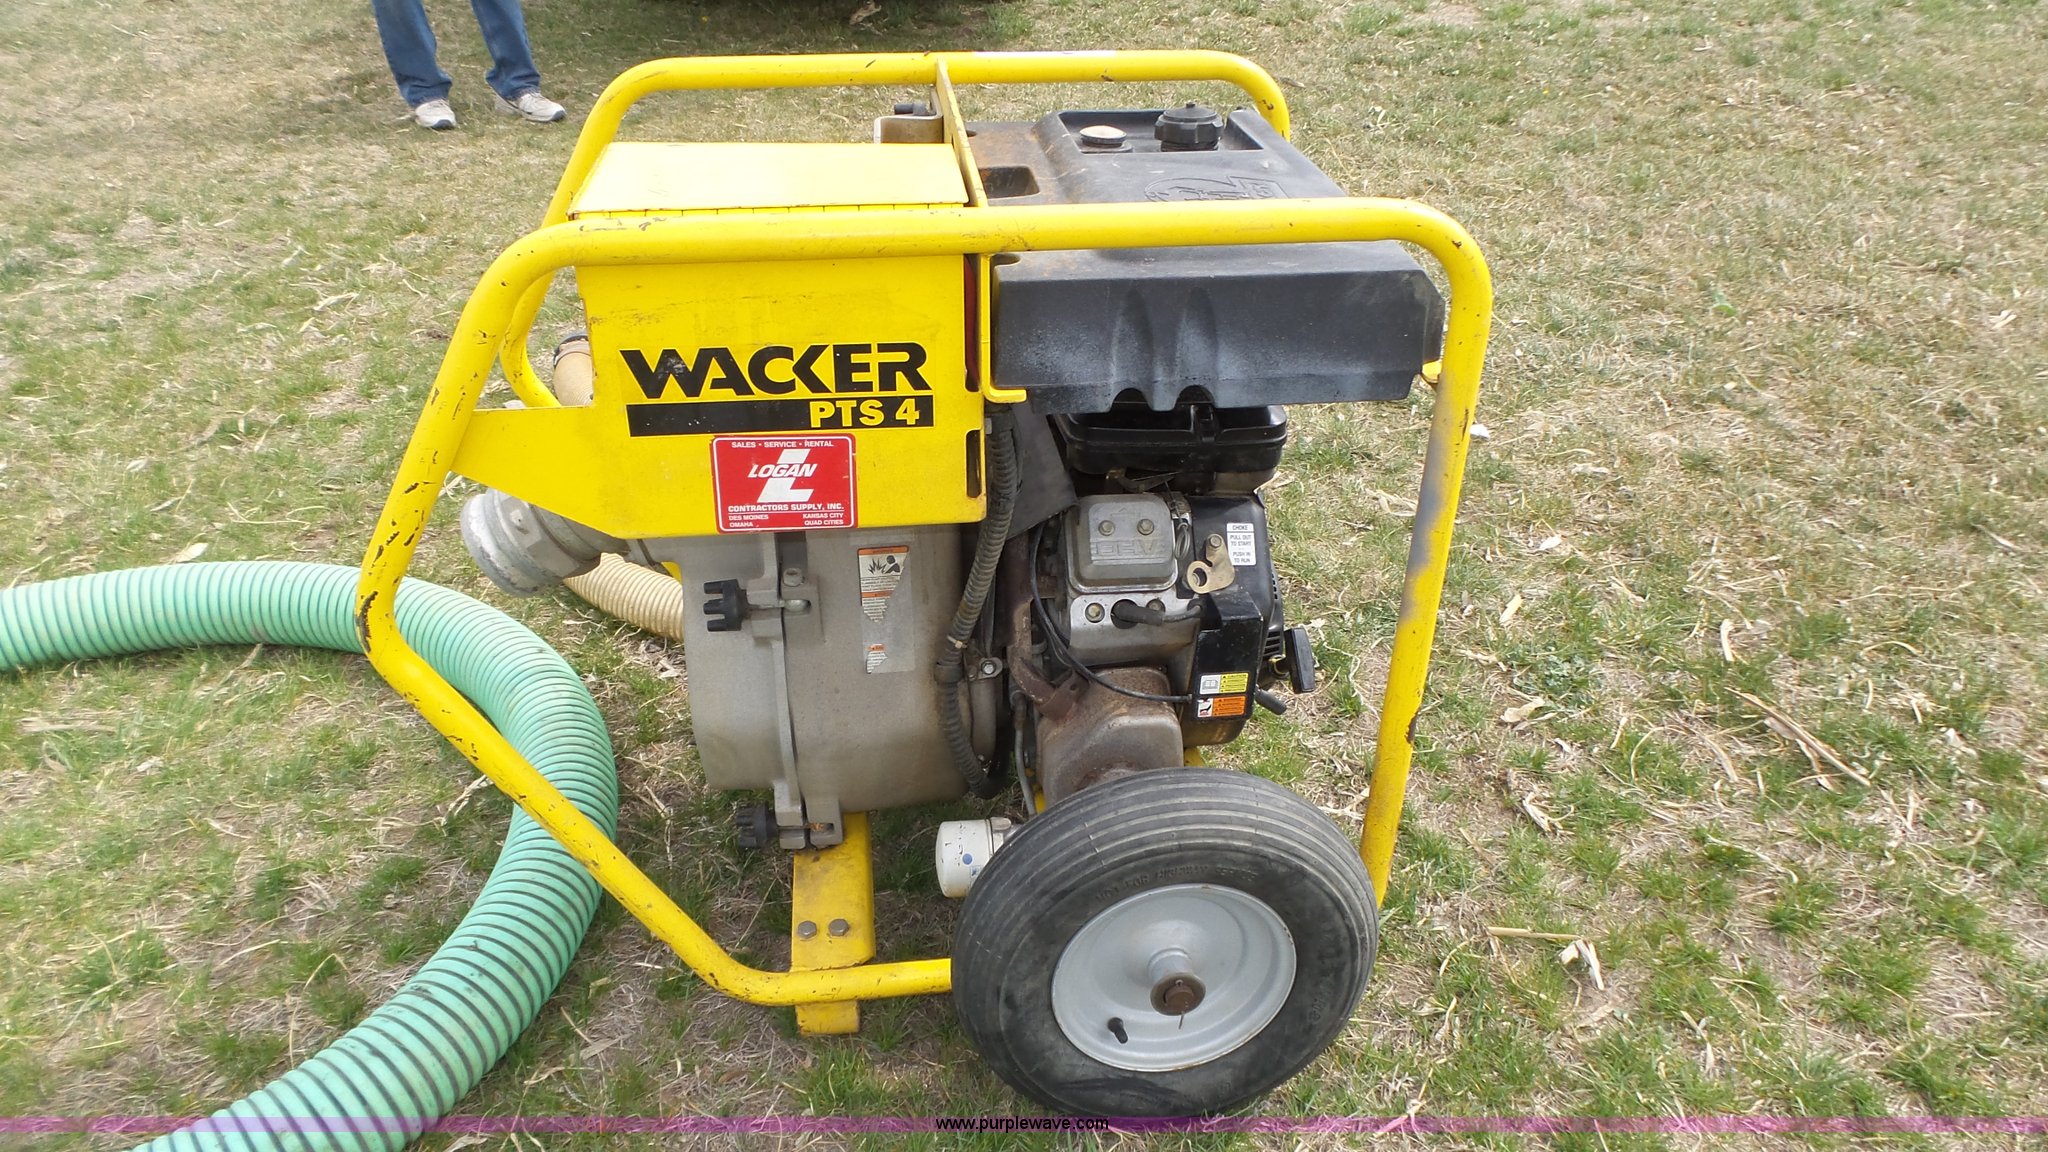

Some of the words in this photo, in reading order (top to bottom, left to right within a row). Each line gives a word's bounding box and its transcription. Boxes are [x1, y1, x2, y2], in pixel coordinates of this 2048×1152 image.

[619, 342, 932, 399] WACKER
[809, 400, 884, 428] PTS
[895, 398, 920, 425] 4
[747, 463, 818, 478] LOGAN
[728, 504, 789, 512] CONTRACTORS
[790, 503, 825, 511] SUPPLY,
